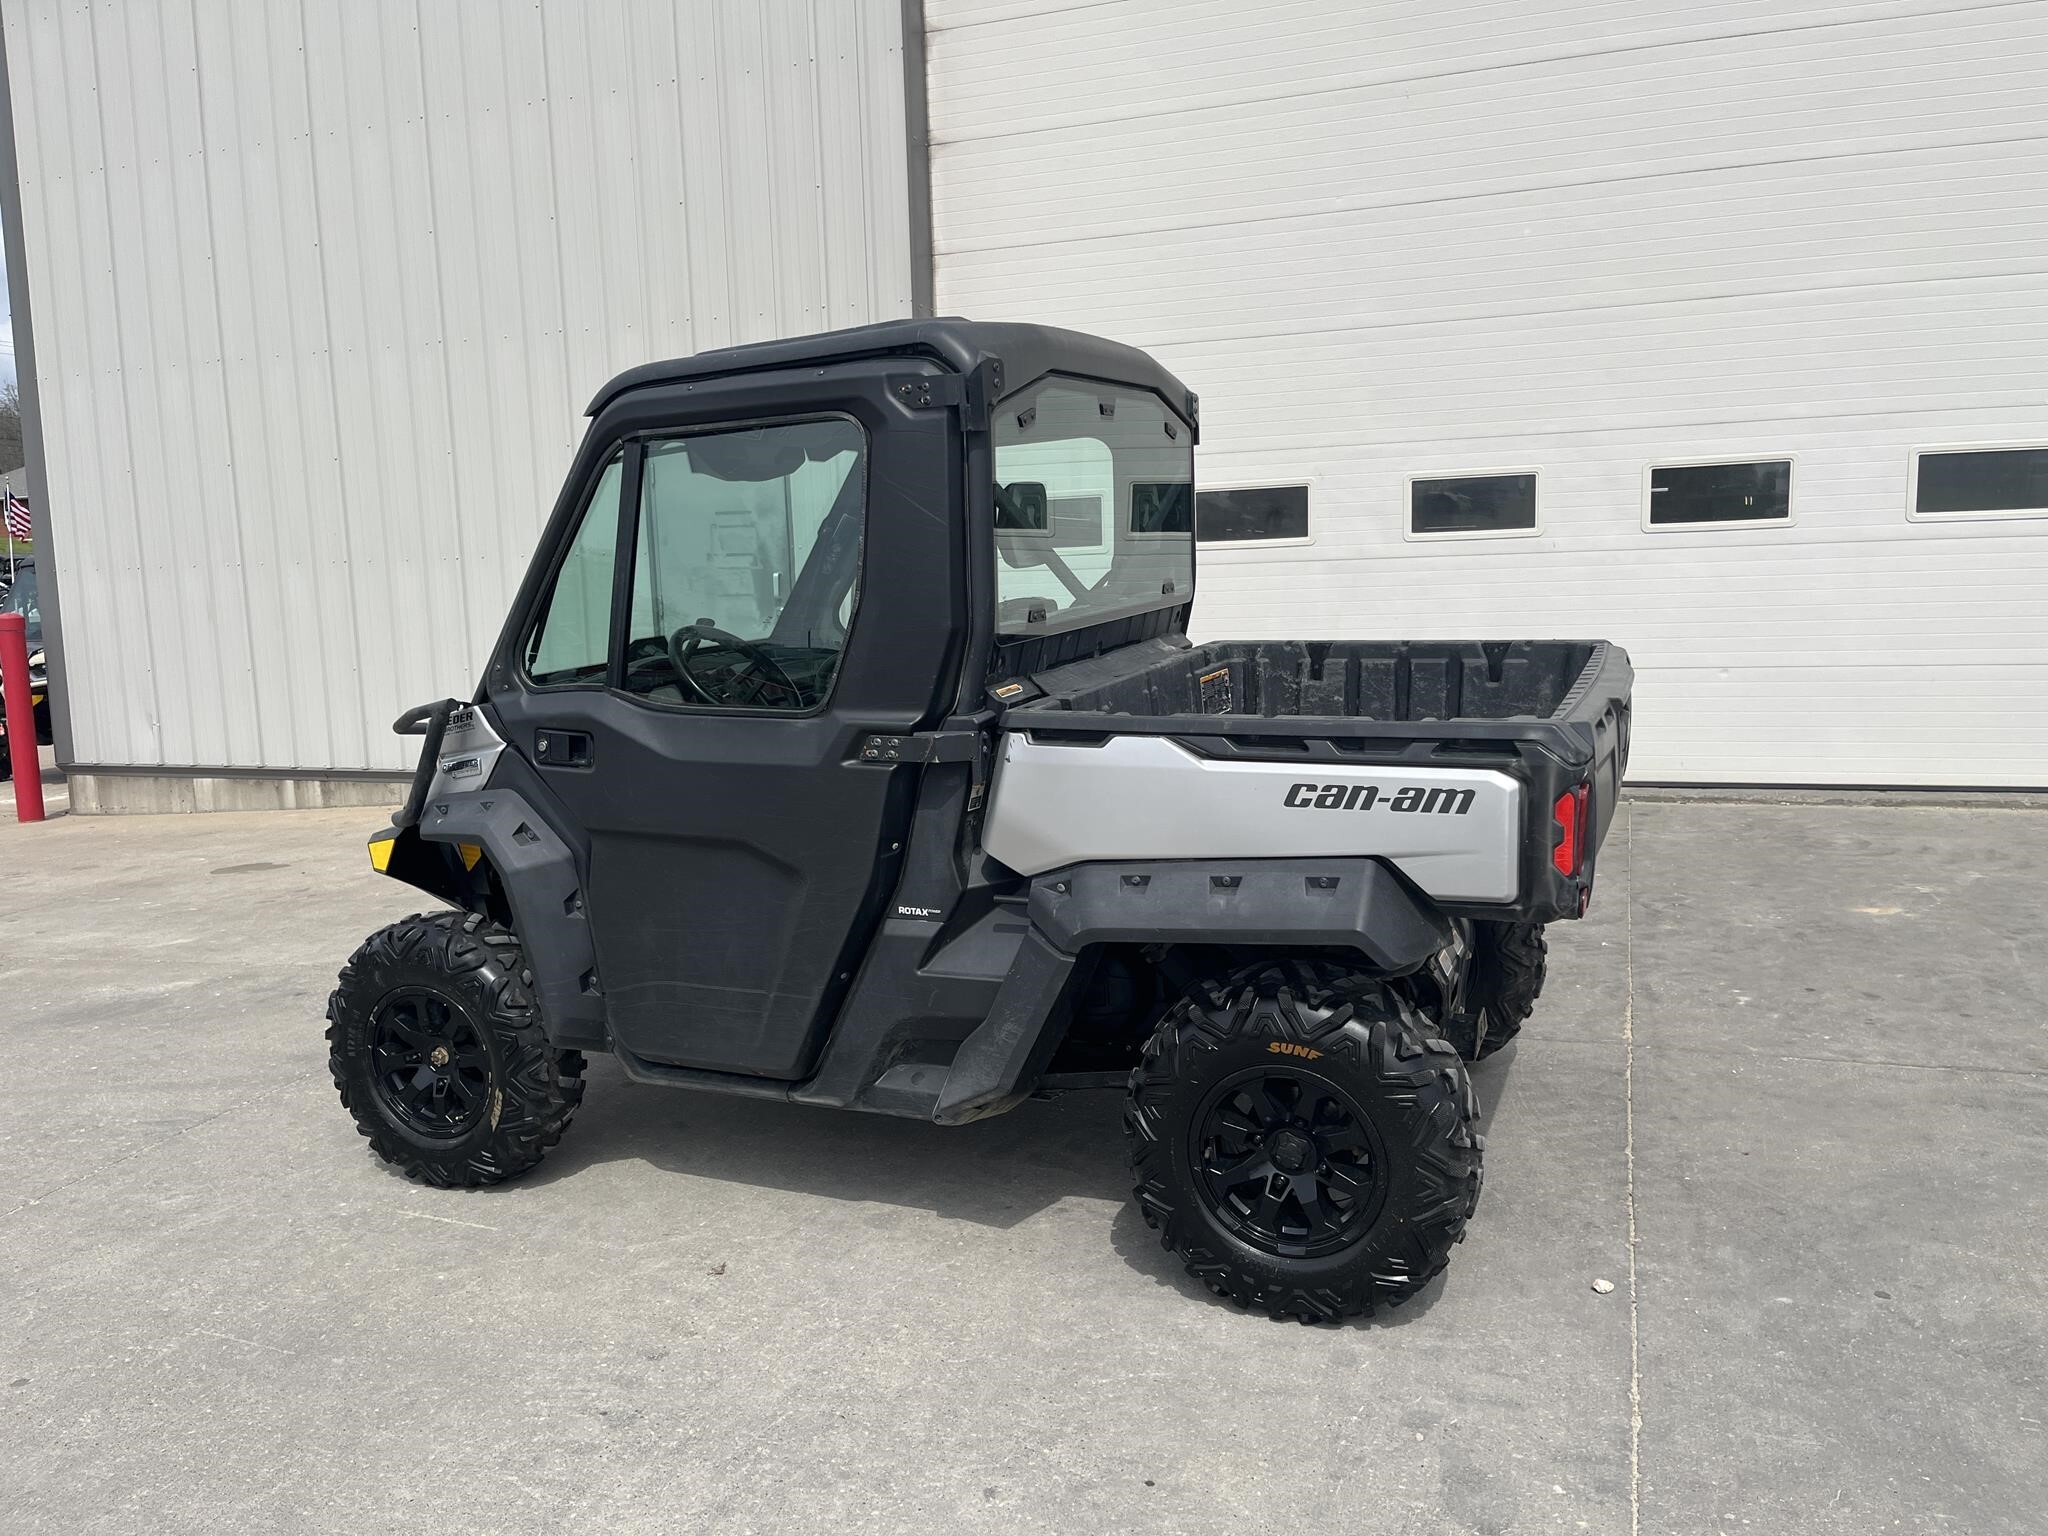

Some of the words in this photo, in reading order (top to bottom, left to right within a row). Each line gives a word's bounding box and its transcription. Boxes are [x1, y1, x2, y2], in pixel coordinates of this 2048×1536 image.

[445, 722, 472, 732] ROTHERS
[1283, 783, 1476, 815] can-am
[898, 906, 929, 917] ROTAX
[1265, 1041, 1325, 1060] SUNF
